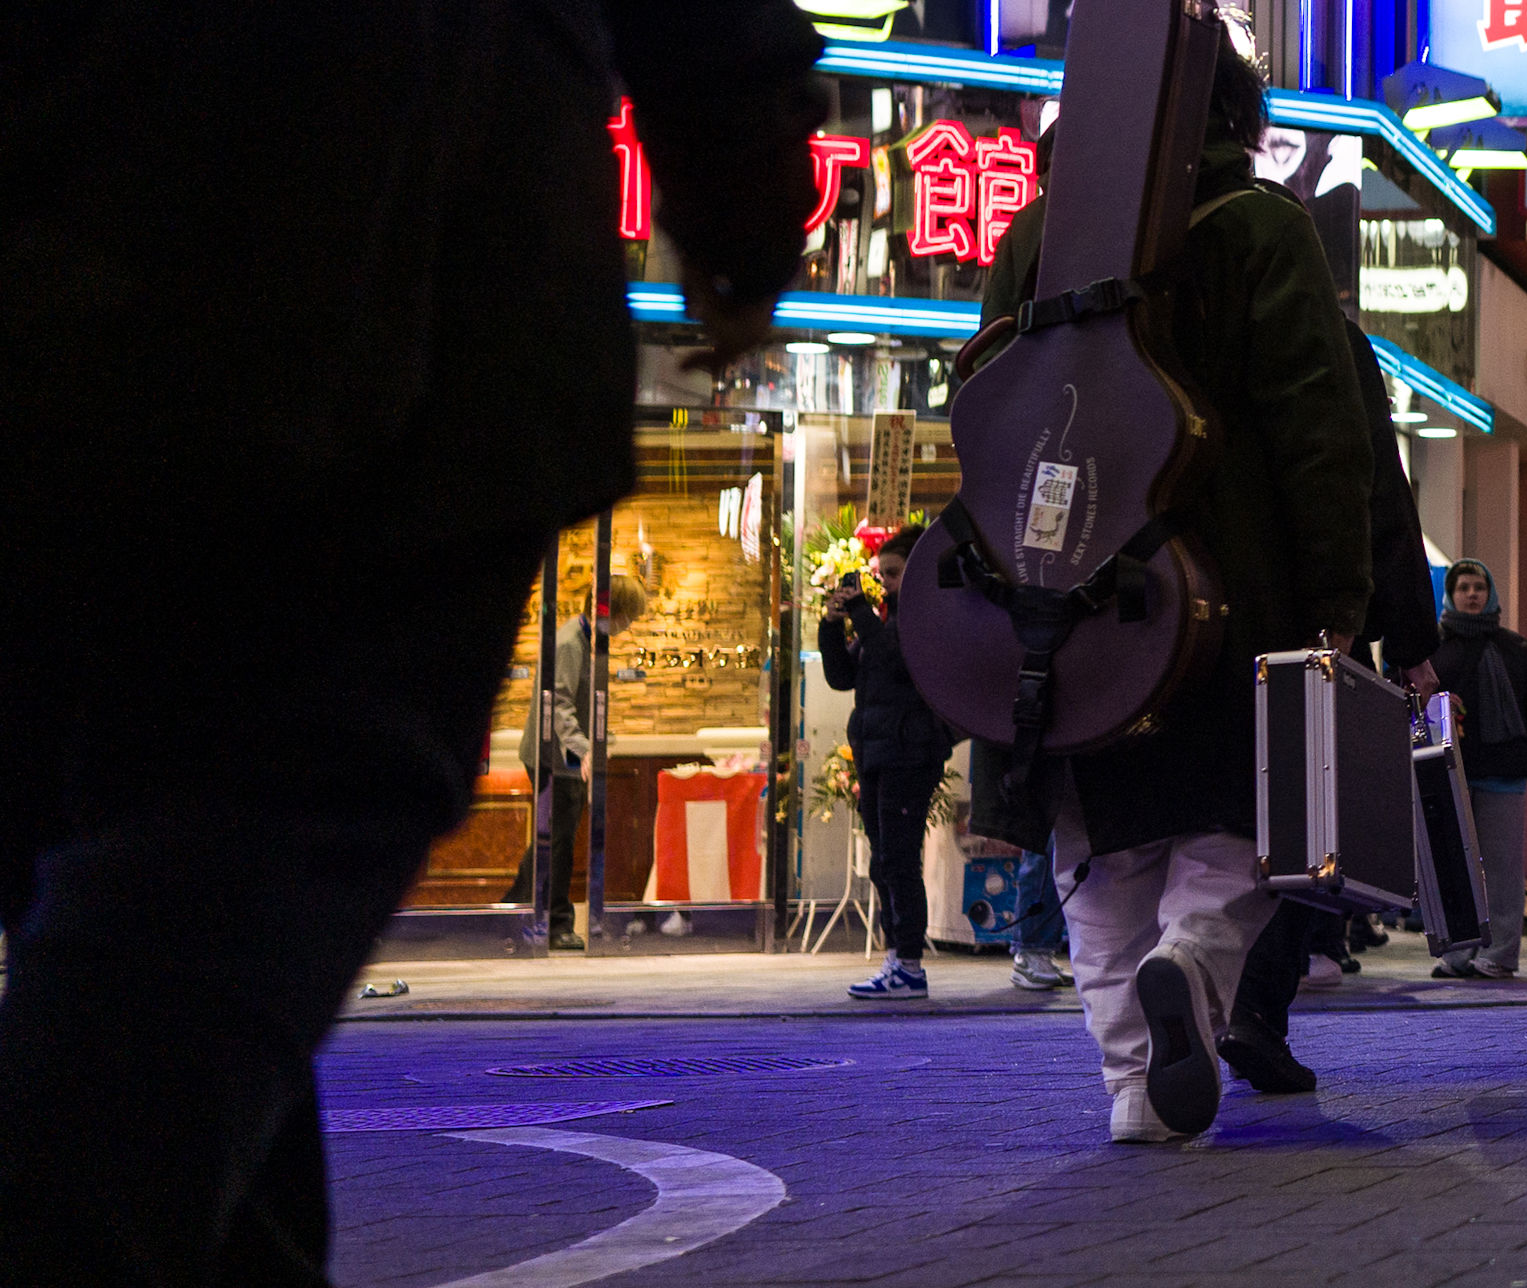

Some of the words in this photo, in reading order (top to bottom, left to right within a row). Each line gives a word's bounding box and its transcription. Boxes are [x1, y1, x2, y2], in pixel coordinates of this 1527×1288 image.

[1021, 427, 1052, 490] BEAUTIFULLY
[1086, 455, 1098, 502] RECORDS
[1015, 490, 1027, 508] DIE
[1015, 510, 1025, 559] STRAIGHT
[1080, 502, 1097, 541] STONES
[1016, 560, 1029, 584] LIVE
